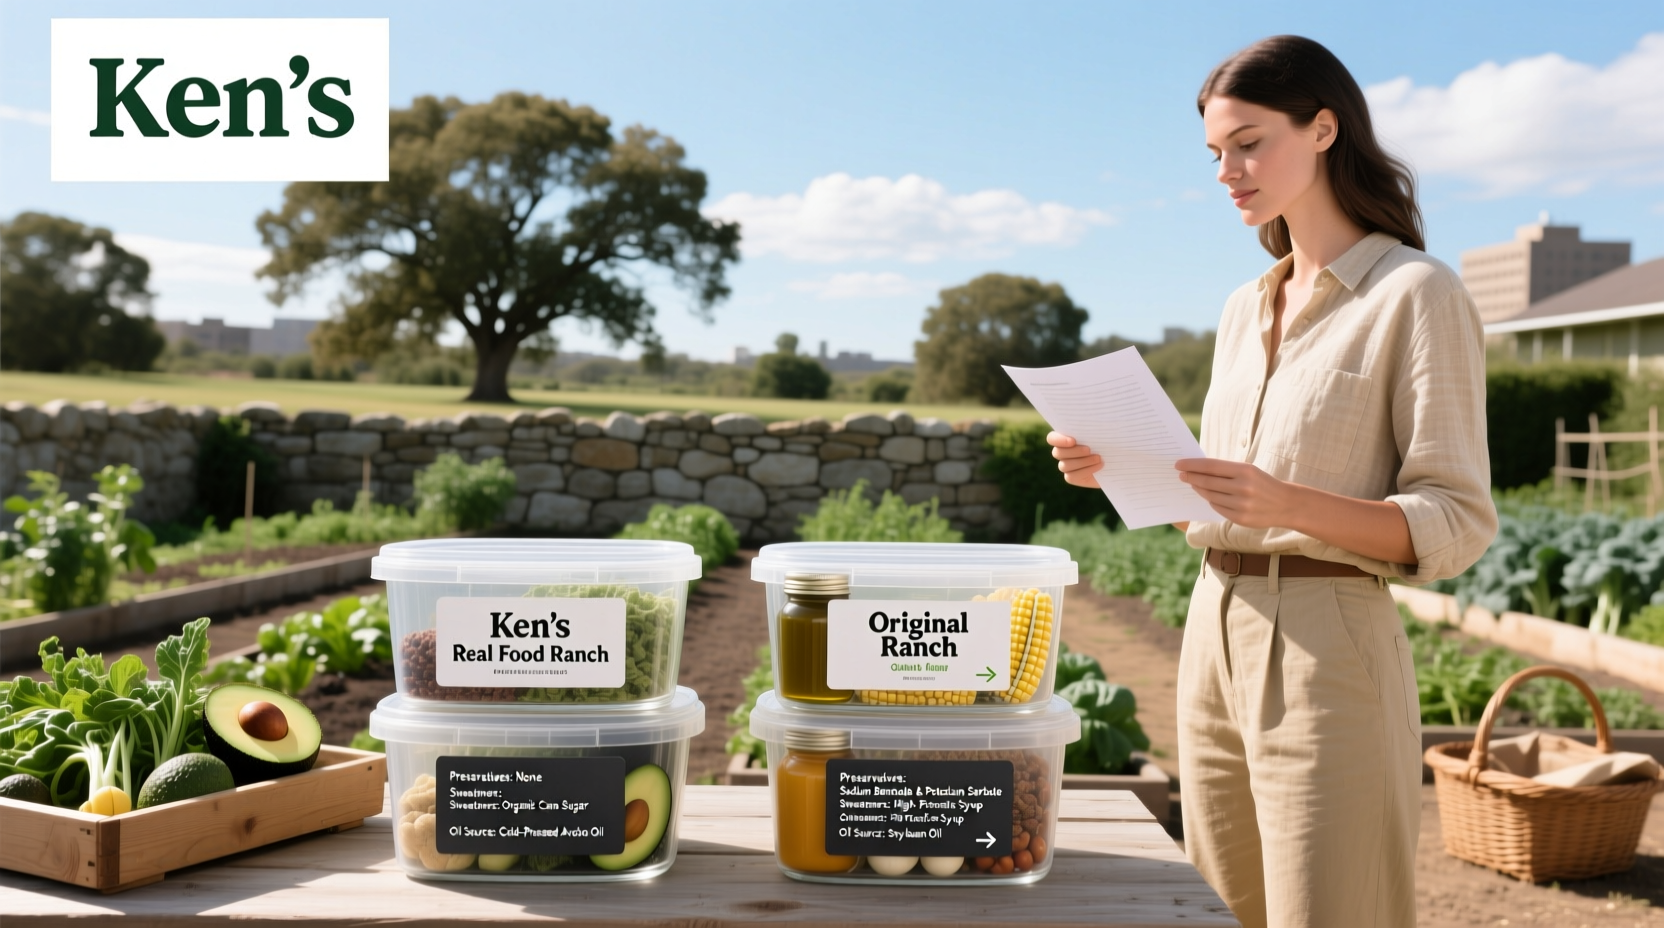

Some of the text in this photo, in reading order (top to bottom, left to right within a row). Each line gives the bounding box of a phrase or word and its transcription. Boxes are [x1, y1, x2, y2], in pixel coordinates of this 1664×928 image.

[490, 611, 571, 638] Ken’s
[868, 611, 969, 641] Original
[453, 644, 609, 662] Real Food Ranch
[881, 636, 959, 658] Ranch
[562, 800, 590, 814] Sugar
